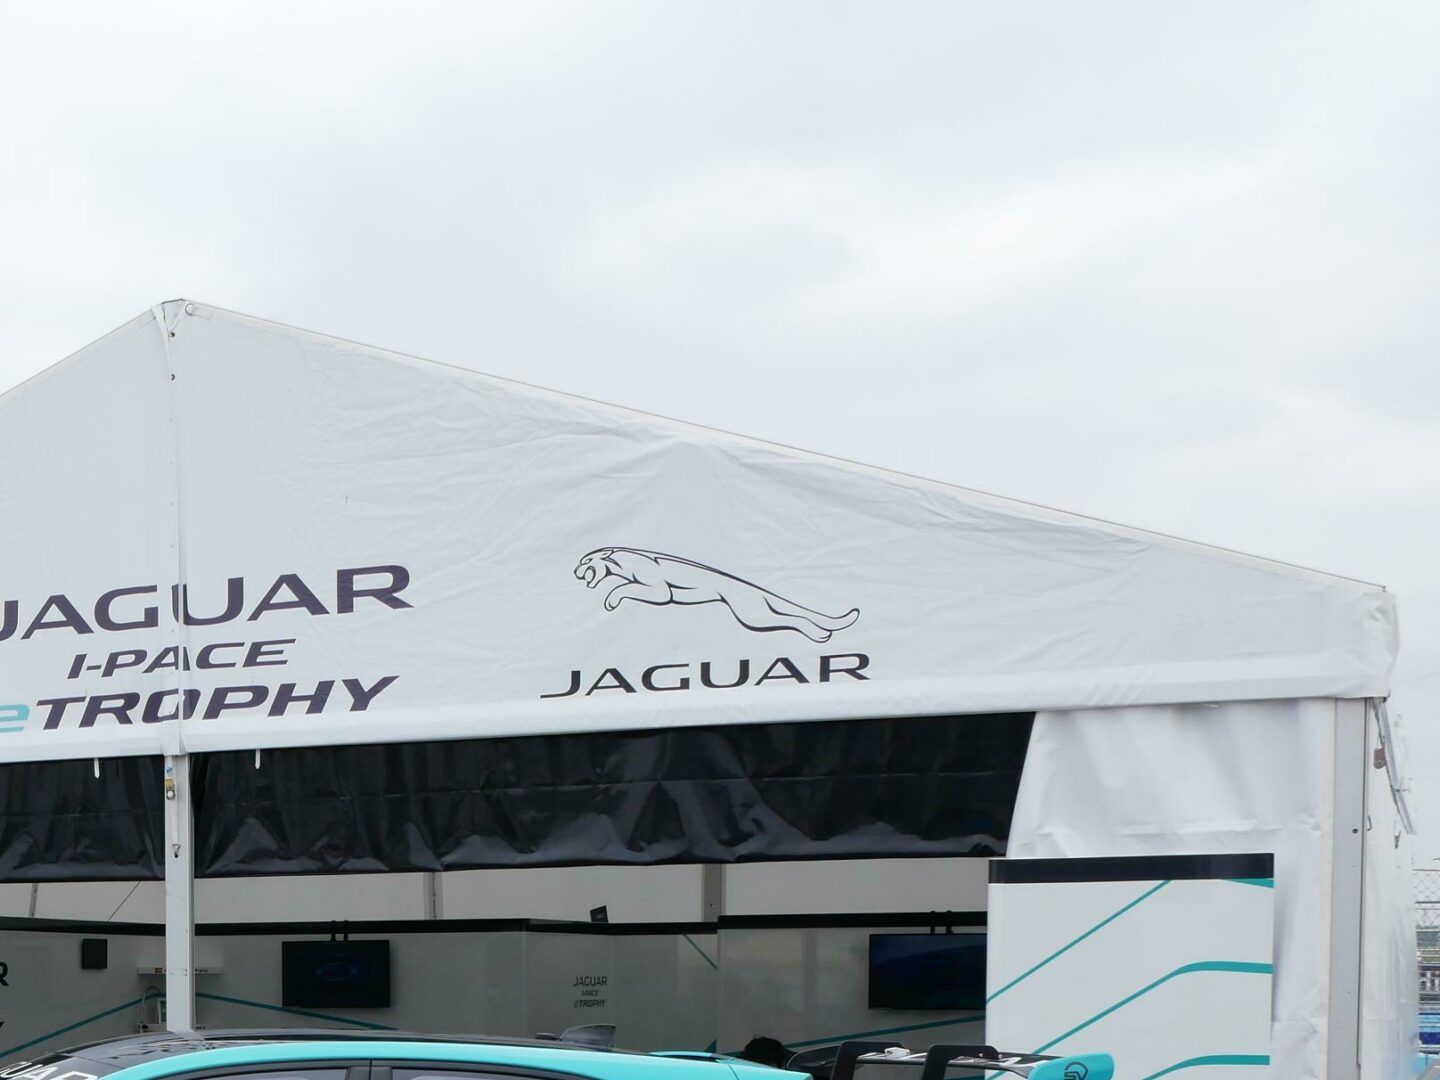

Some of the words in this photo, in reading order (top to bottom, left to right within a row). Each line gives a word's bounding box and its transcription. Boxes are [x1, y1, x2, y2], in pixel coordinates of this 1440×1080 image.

[66, 638, 297, 680] I-PACE
[540, 652, 871, 699] JAGUAR
[572, 976, 608, 987] JAGUAR
